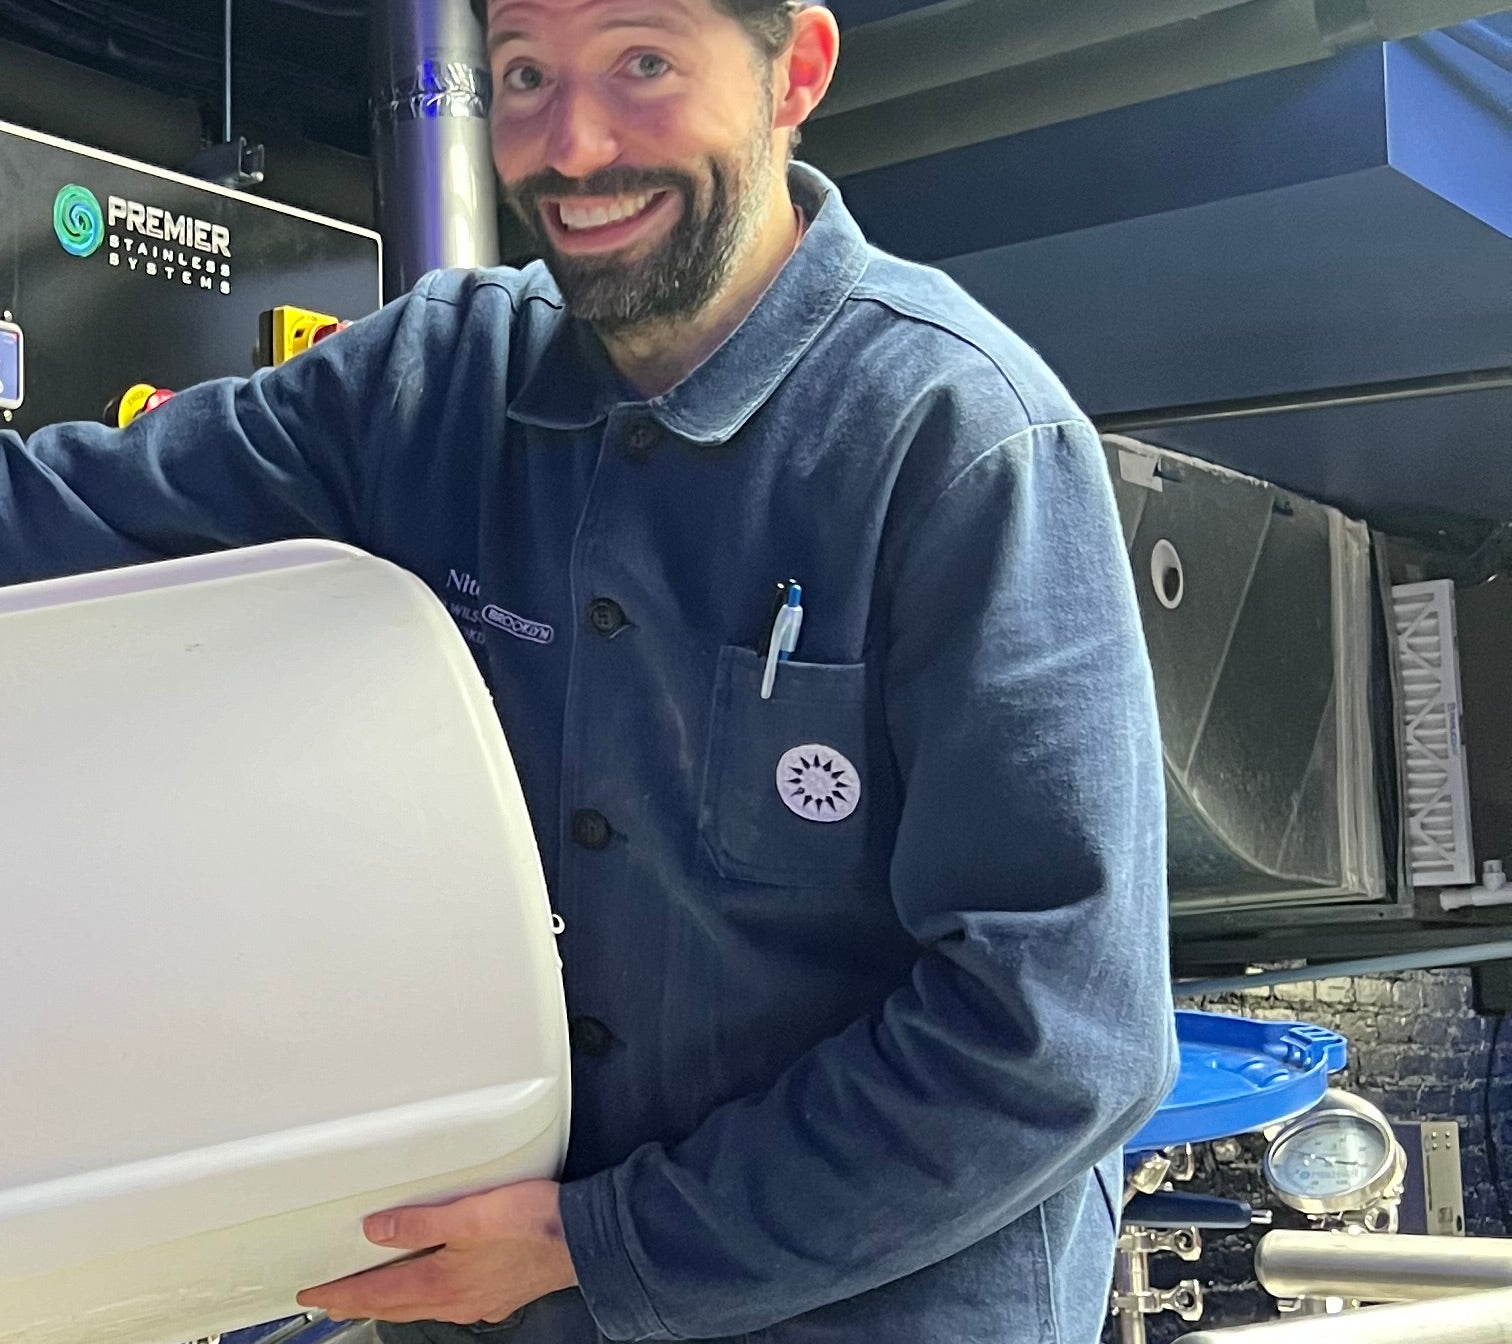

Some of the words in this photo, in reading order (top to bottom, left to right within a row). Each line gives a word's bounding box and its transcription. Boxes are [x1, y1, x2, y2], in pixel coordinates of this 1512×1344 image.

[108, 195, 231, 258] PREMIER
[109, 234, 231, 278] STAINLESS
[109, 252, 230, 295] SYSTEMS
